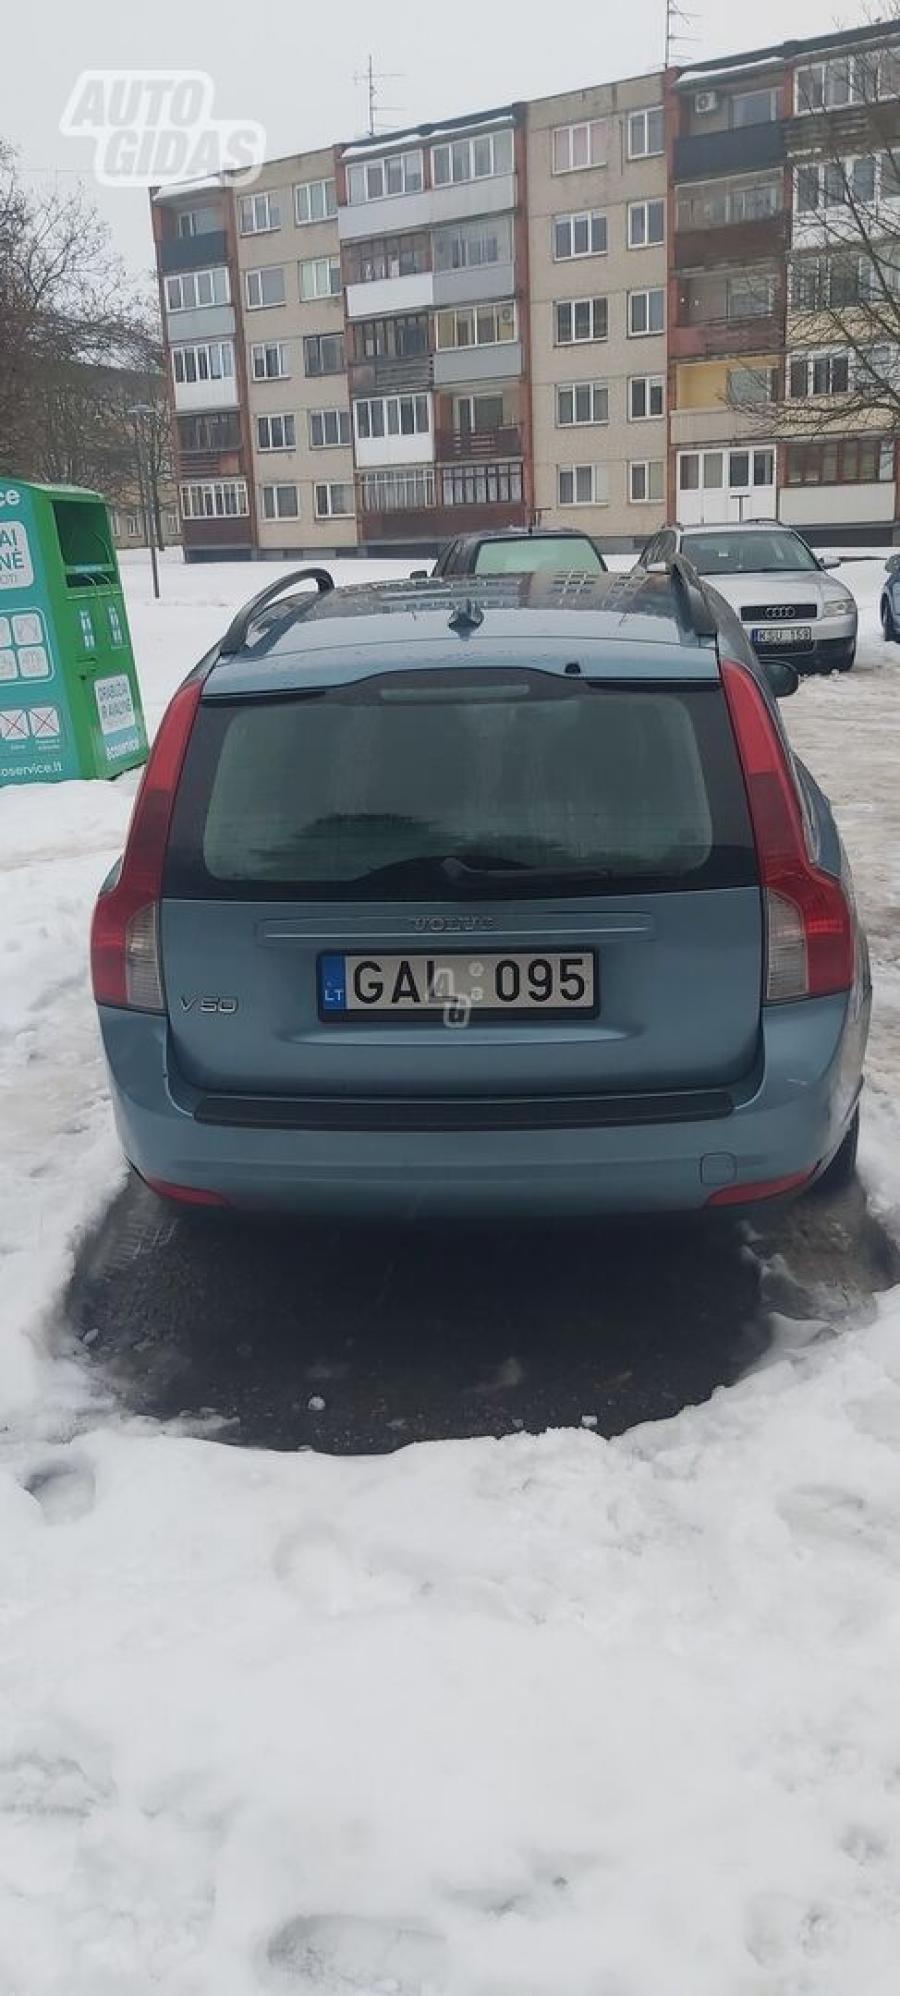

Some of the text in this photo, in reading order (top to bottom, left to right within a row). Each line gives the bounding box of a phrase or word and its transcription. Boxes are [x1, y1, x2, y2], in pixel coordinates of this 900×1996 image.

[353, 959, 459, 1004] GAL
[495, 958, 586, 1002] 095
[324, 990, 342, 1001] LT
